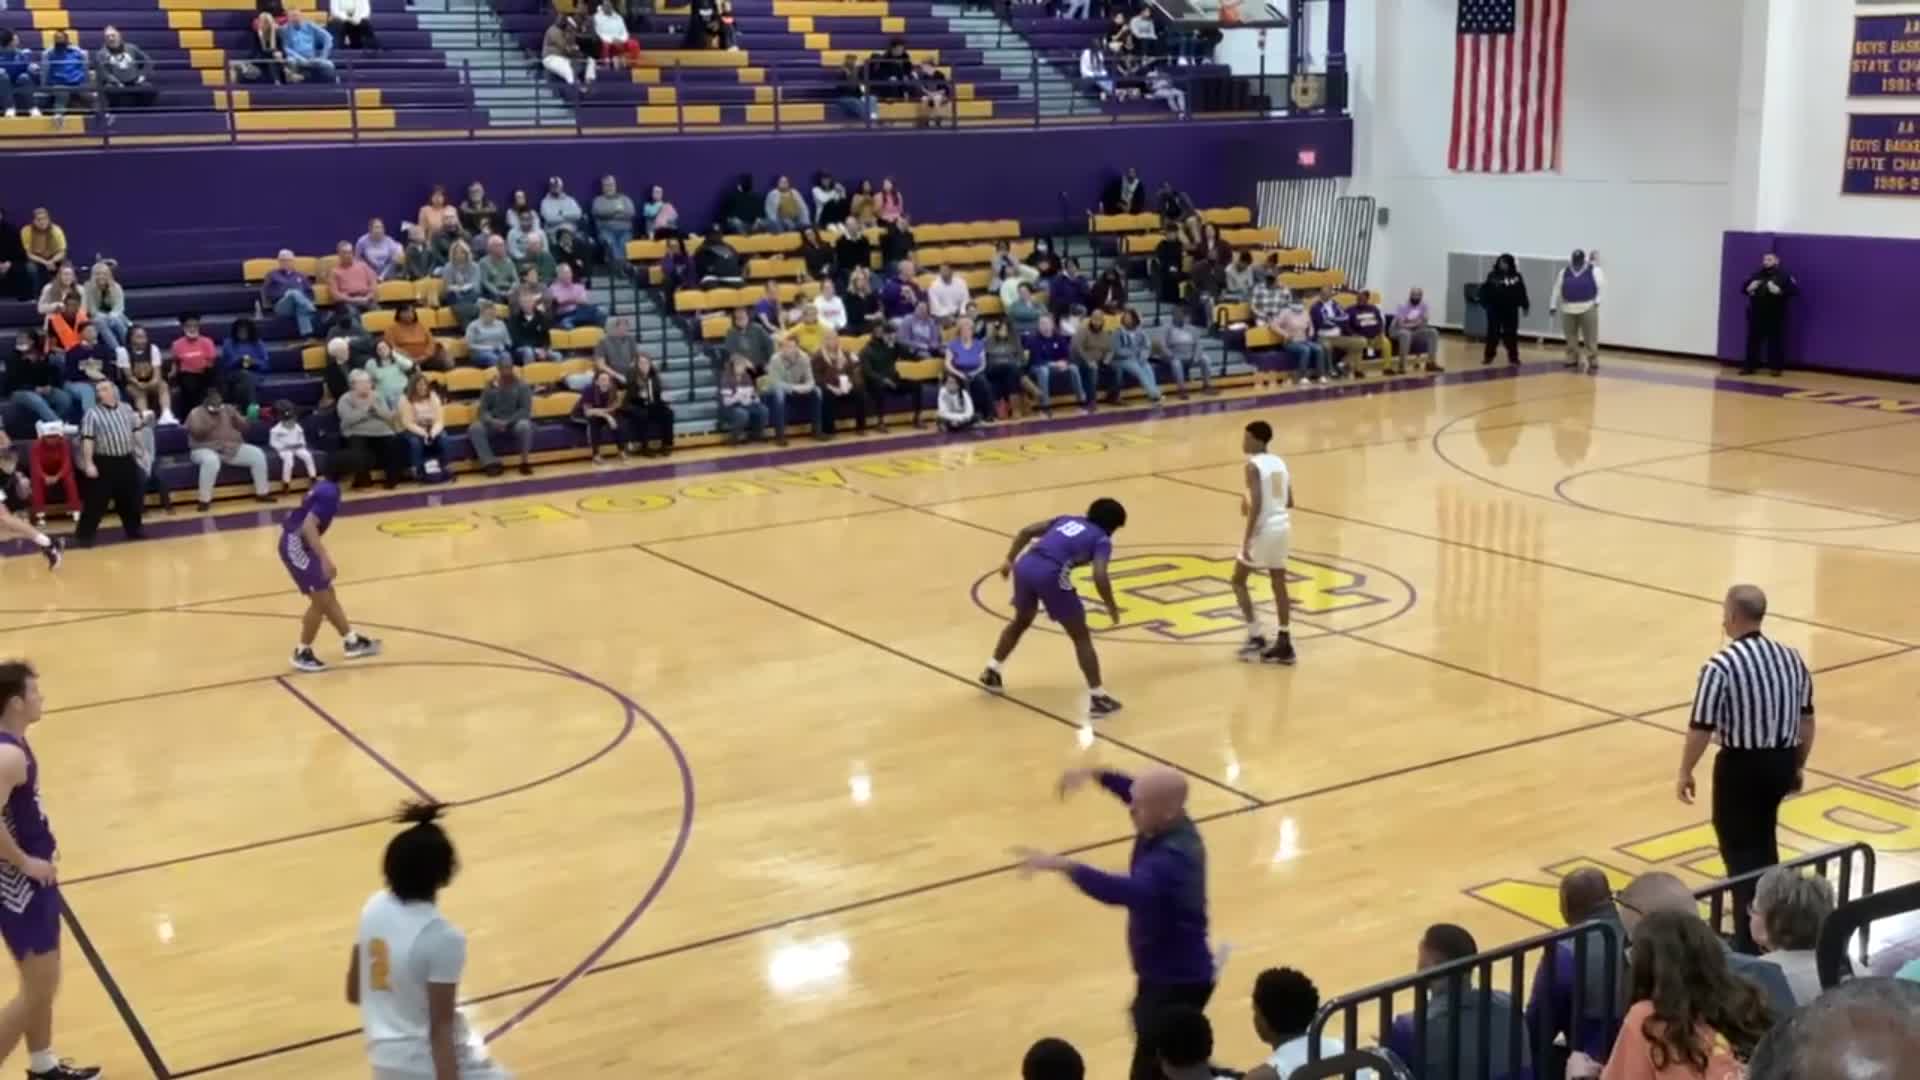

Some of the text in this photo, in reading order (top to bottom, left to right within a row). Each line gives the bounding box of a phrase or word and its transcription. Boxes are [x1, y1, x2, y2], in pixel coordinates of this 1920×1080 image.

[1856, 41, 1888, 54] BOYS
[1851, 60, 1890, 73] STATE
[1849, 139, 1881, 153] BOYS
[1847, 157, 1886, 171] STATE
